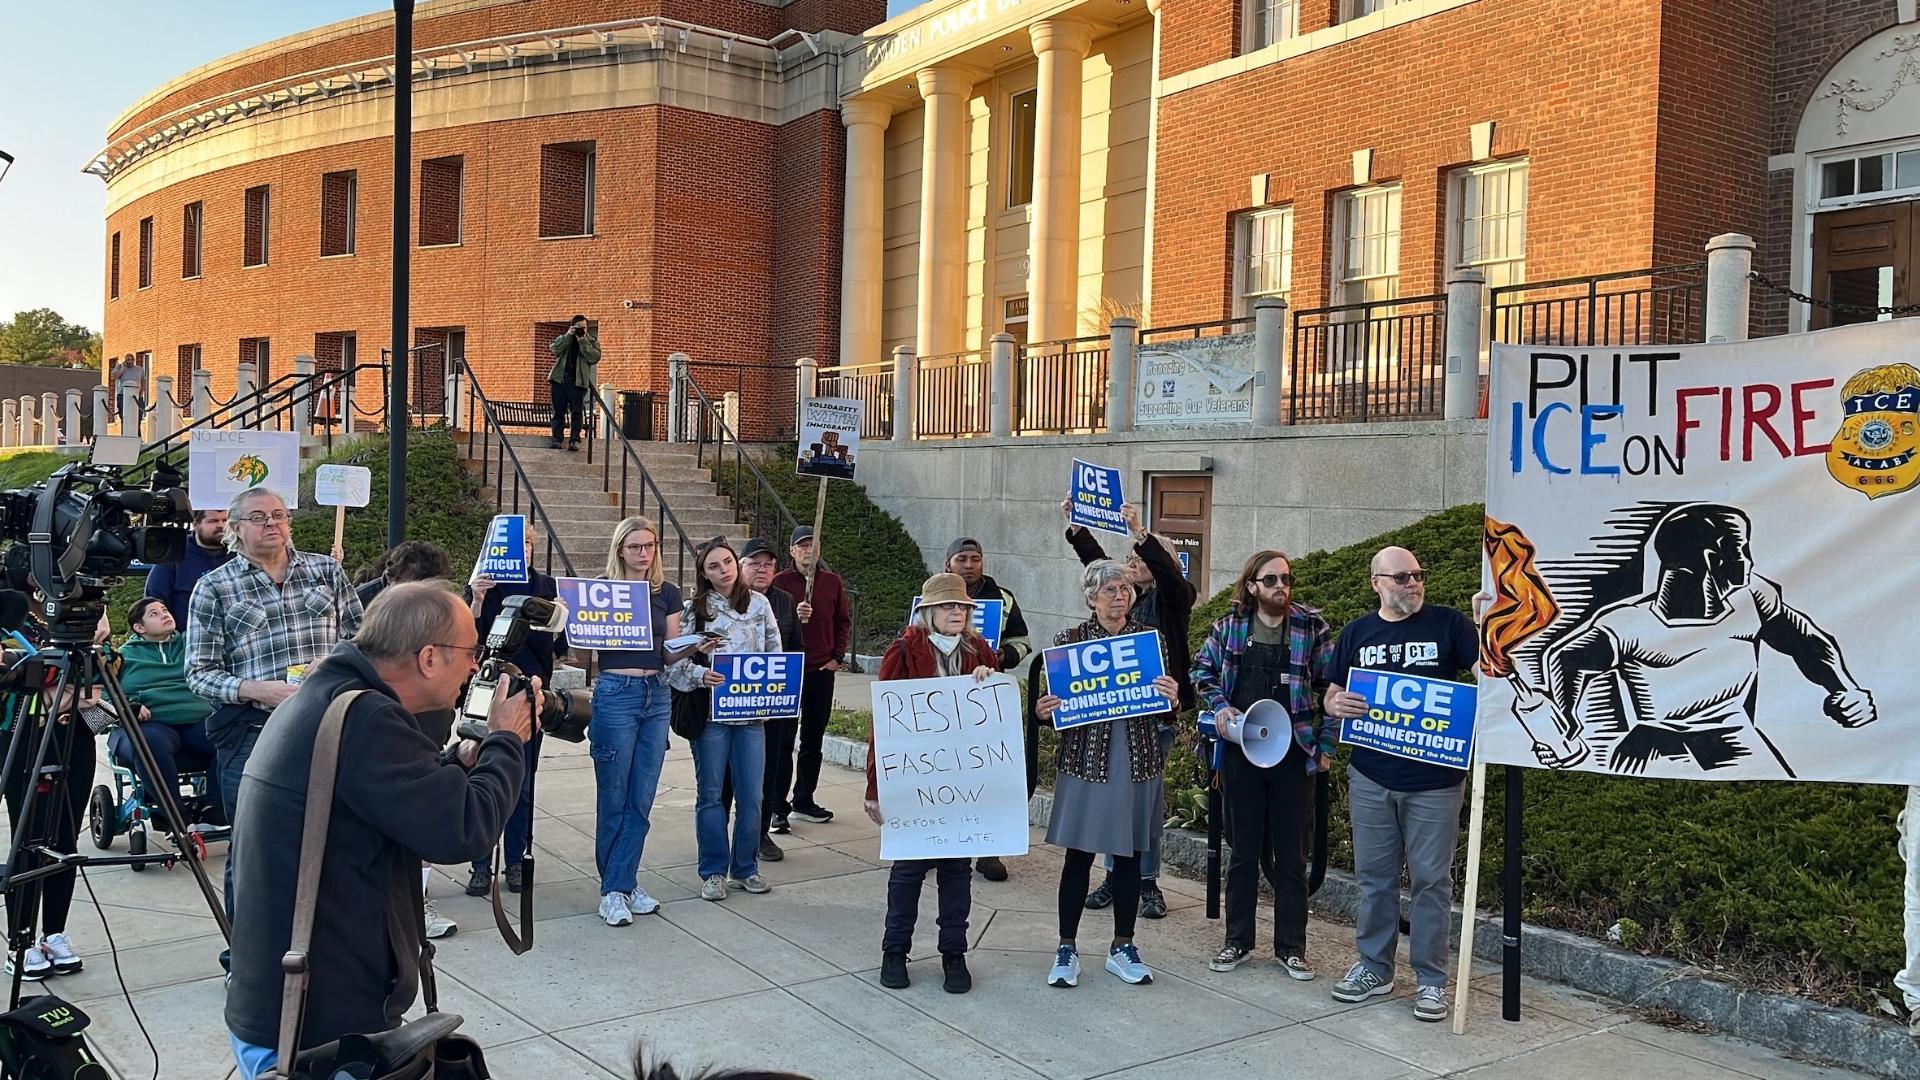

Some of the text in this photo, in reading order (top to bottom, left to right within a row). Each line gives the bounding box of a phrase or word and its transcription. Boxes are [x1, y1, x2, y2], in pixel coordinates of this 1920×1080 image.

[929, 0, 987, 41] POLICE
[1145, 359, 1186, 376] Honoring
[1529, 352, 1681, 420] PUT
[808, 401, 859, 413] SOLIDARITY
[1139, 397, 1250, 418] Supporting Our Veterans
[1854, 393, 1912, 413] ICE
[806, 408, 860, 426] WITH
[806, 421, 857, 432] IMMIGRANTS
[1510, 377, 1835, 477] ICE ON FIRE
[191, 430, 246, 443] NO ICE
[1853, 457, 1902, 469] ACAB
[1078, 464, 1110, 495] ICE
[1078, 491, 1112, 508] OUT OF
[1074, 501, 1124, 523] CONNECTICUT
[491, 546, 508, 556] OF
[483, 558, 522, 570] CTICUT
[578, 582, 632, 609] ICE
[577, 609, 634, 623] OUT OF
[569, 623, 647, 637] CONNECTICUT
[1067, 638, 1139, 678] ICE
[1359, 643, 1426, 668] ICE OUT OF CT
[732, 656, 787, 681] ICE
[729, 682, 787, 694] OUT OF
[1069, 670, 1142, 694] OUT OF
[718, 695, 797, 708] CONNECTICUT
[1060, 684, 1161, 713] CONNECTICUT
[1374, 675, 1454, 716] ICE
[881, 681, 1013, 737] RESIST
[1108, 705, 1129, 716] NOT
[1142, 700, 1165, 709] People
[1368, 708, 1450, 732] OUT OF
[1351, 719, 1466, 753] CONNECTICUT
[881, 740, 1013, 781] FASCISM
[1402, 746, 1426, 757] NOT
[1427, 750, 1439, 758] the
[1439, 753, 1465, 763] People
[916, 784, 985, 807] NOW
[887, 817, 946, 830] BEFORE
[37, 1006, 70, 1023] TVU
